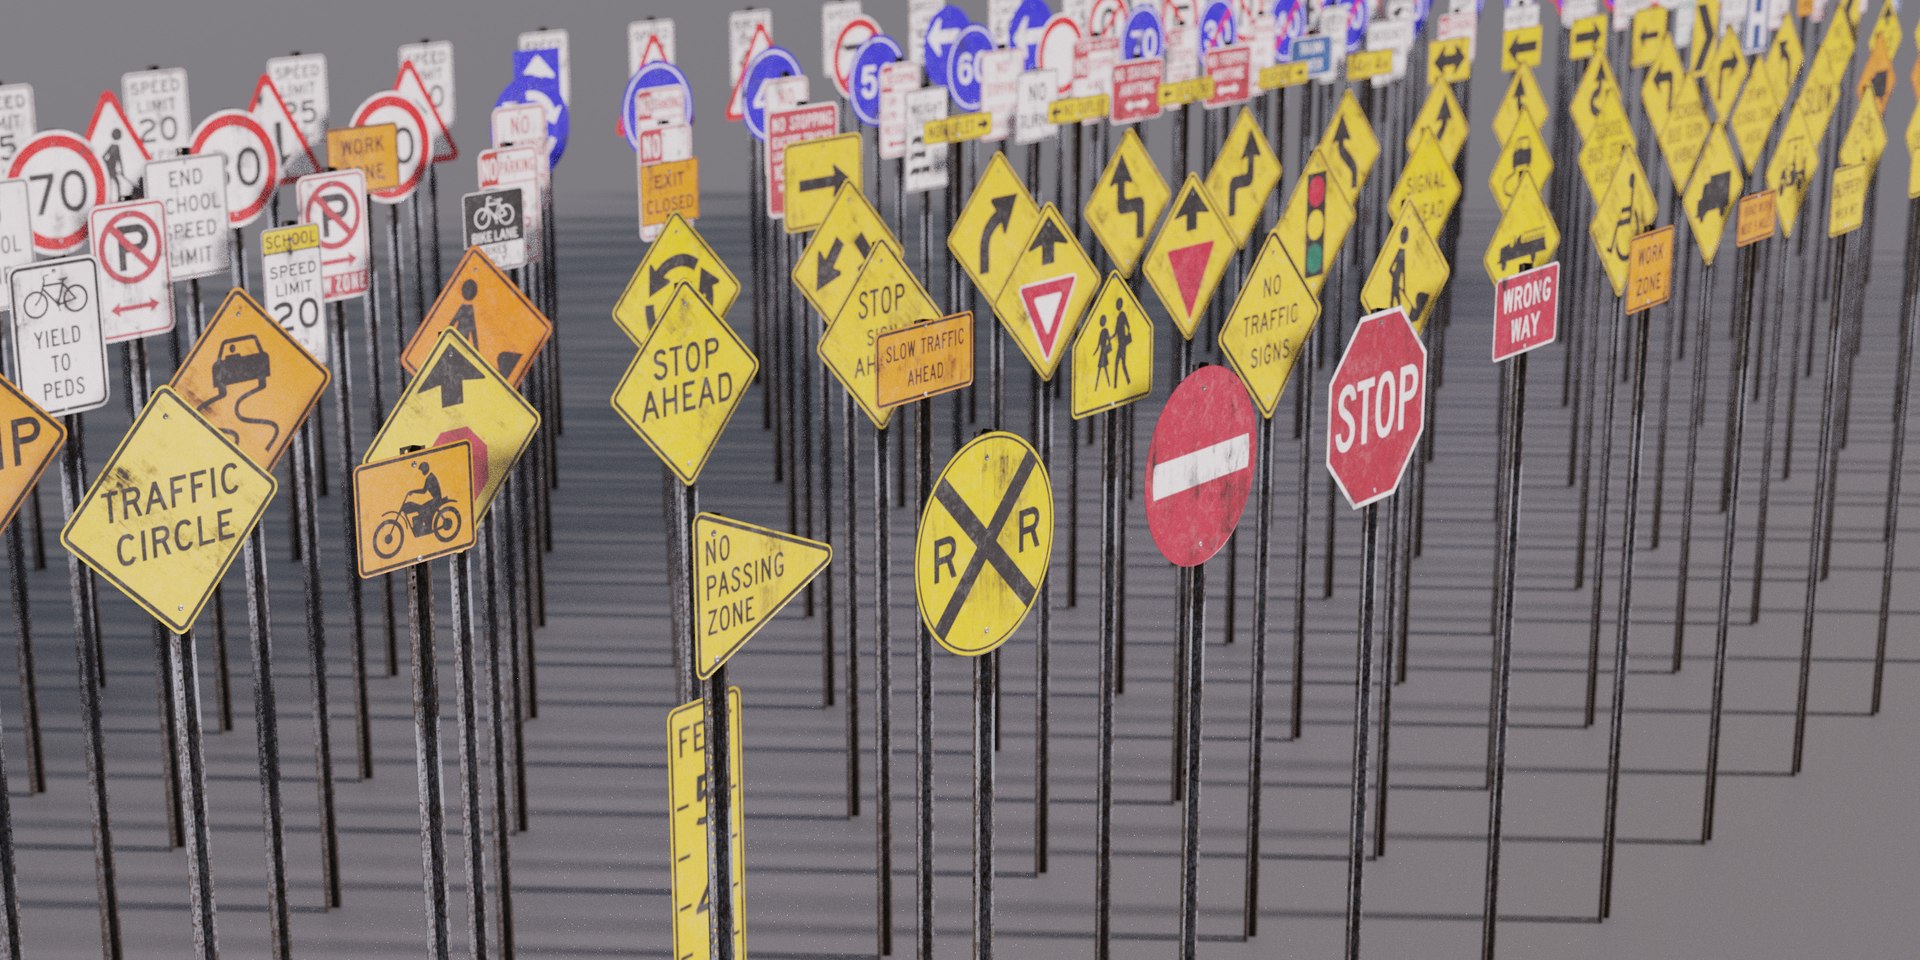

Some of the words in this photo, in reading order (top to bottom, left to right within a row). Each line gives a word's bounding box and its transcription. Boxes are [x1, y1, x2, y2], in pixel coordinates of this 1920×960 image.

[130, 78, 180, 96] SPEED
[430, 85, 445, 108] 0
[137, 98, 176, 114] LIMIT
[139, 116, 178, 143] 20
[340, 136, 385, 156] WORK
[397, 127, 414, 164] 0
[168, 168, 203, 188] END
[366, 164, 386, 184] NE
[653, 171, 685, 190] EXIT
[1405, 171, 1447, 197] SIGNAL
[29, 169, 88, 216] 70
[166, 192, 222, 215] CHOOL
[646, 194, 694, 215] CLOSED
[265, 229, 317, 250] SCHOOL
[494, 226, 519, 242] LANE
[170, 245, 213, 268] LIMIT
[1637, 241, 1664, 266] WORK
[270, 259, 317, 280] SPEED
[275, 279, 313, 299] LIMIT
[1262, 273, 1282, 299] NO
[1502, 275, 1552, 315] WRONG
[1635, 271, 1662, 297] ZONE
[274, 297, 319, 331] 20
[858, 283, 906, 320] STOP
[1243, 302, 1299, 336] TRAFFIC
[1510, 314, 1542, 344] WAY
[33, 325, 82, 350] YIELD
[885, 338, 916, 364] SLOW
[920, 327, 966, 353] TRAFFIC
[52, 354, 71, 374] TO
[653, 337, 720, 381] STOP
[1250, 343, 1291, 370] SIGNS
[907, 361, 944, 387] AHEAD
[44, 376, 86, 401] PEDS
[641, 371, 734, 424] AHEAD
[1334, 363, 1420, 454] STOP
[100, 461, 240, 525] TRAFFIC
[116, 507, 237, 567] CIRCLE
[933, 535, 958, 585] R
[1018, 505, 1041, 554] R
[705, 534, 731, 567] NO
[705, 551, 786, 602] PASSING
[707, 596, 756, 637] ZONE
[678, 718, 706, 759] FE
